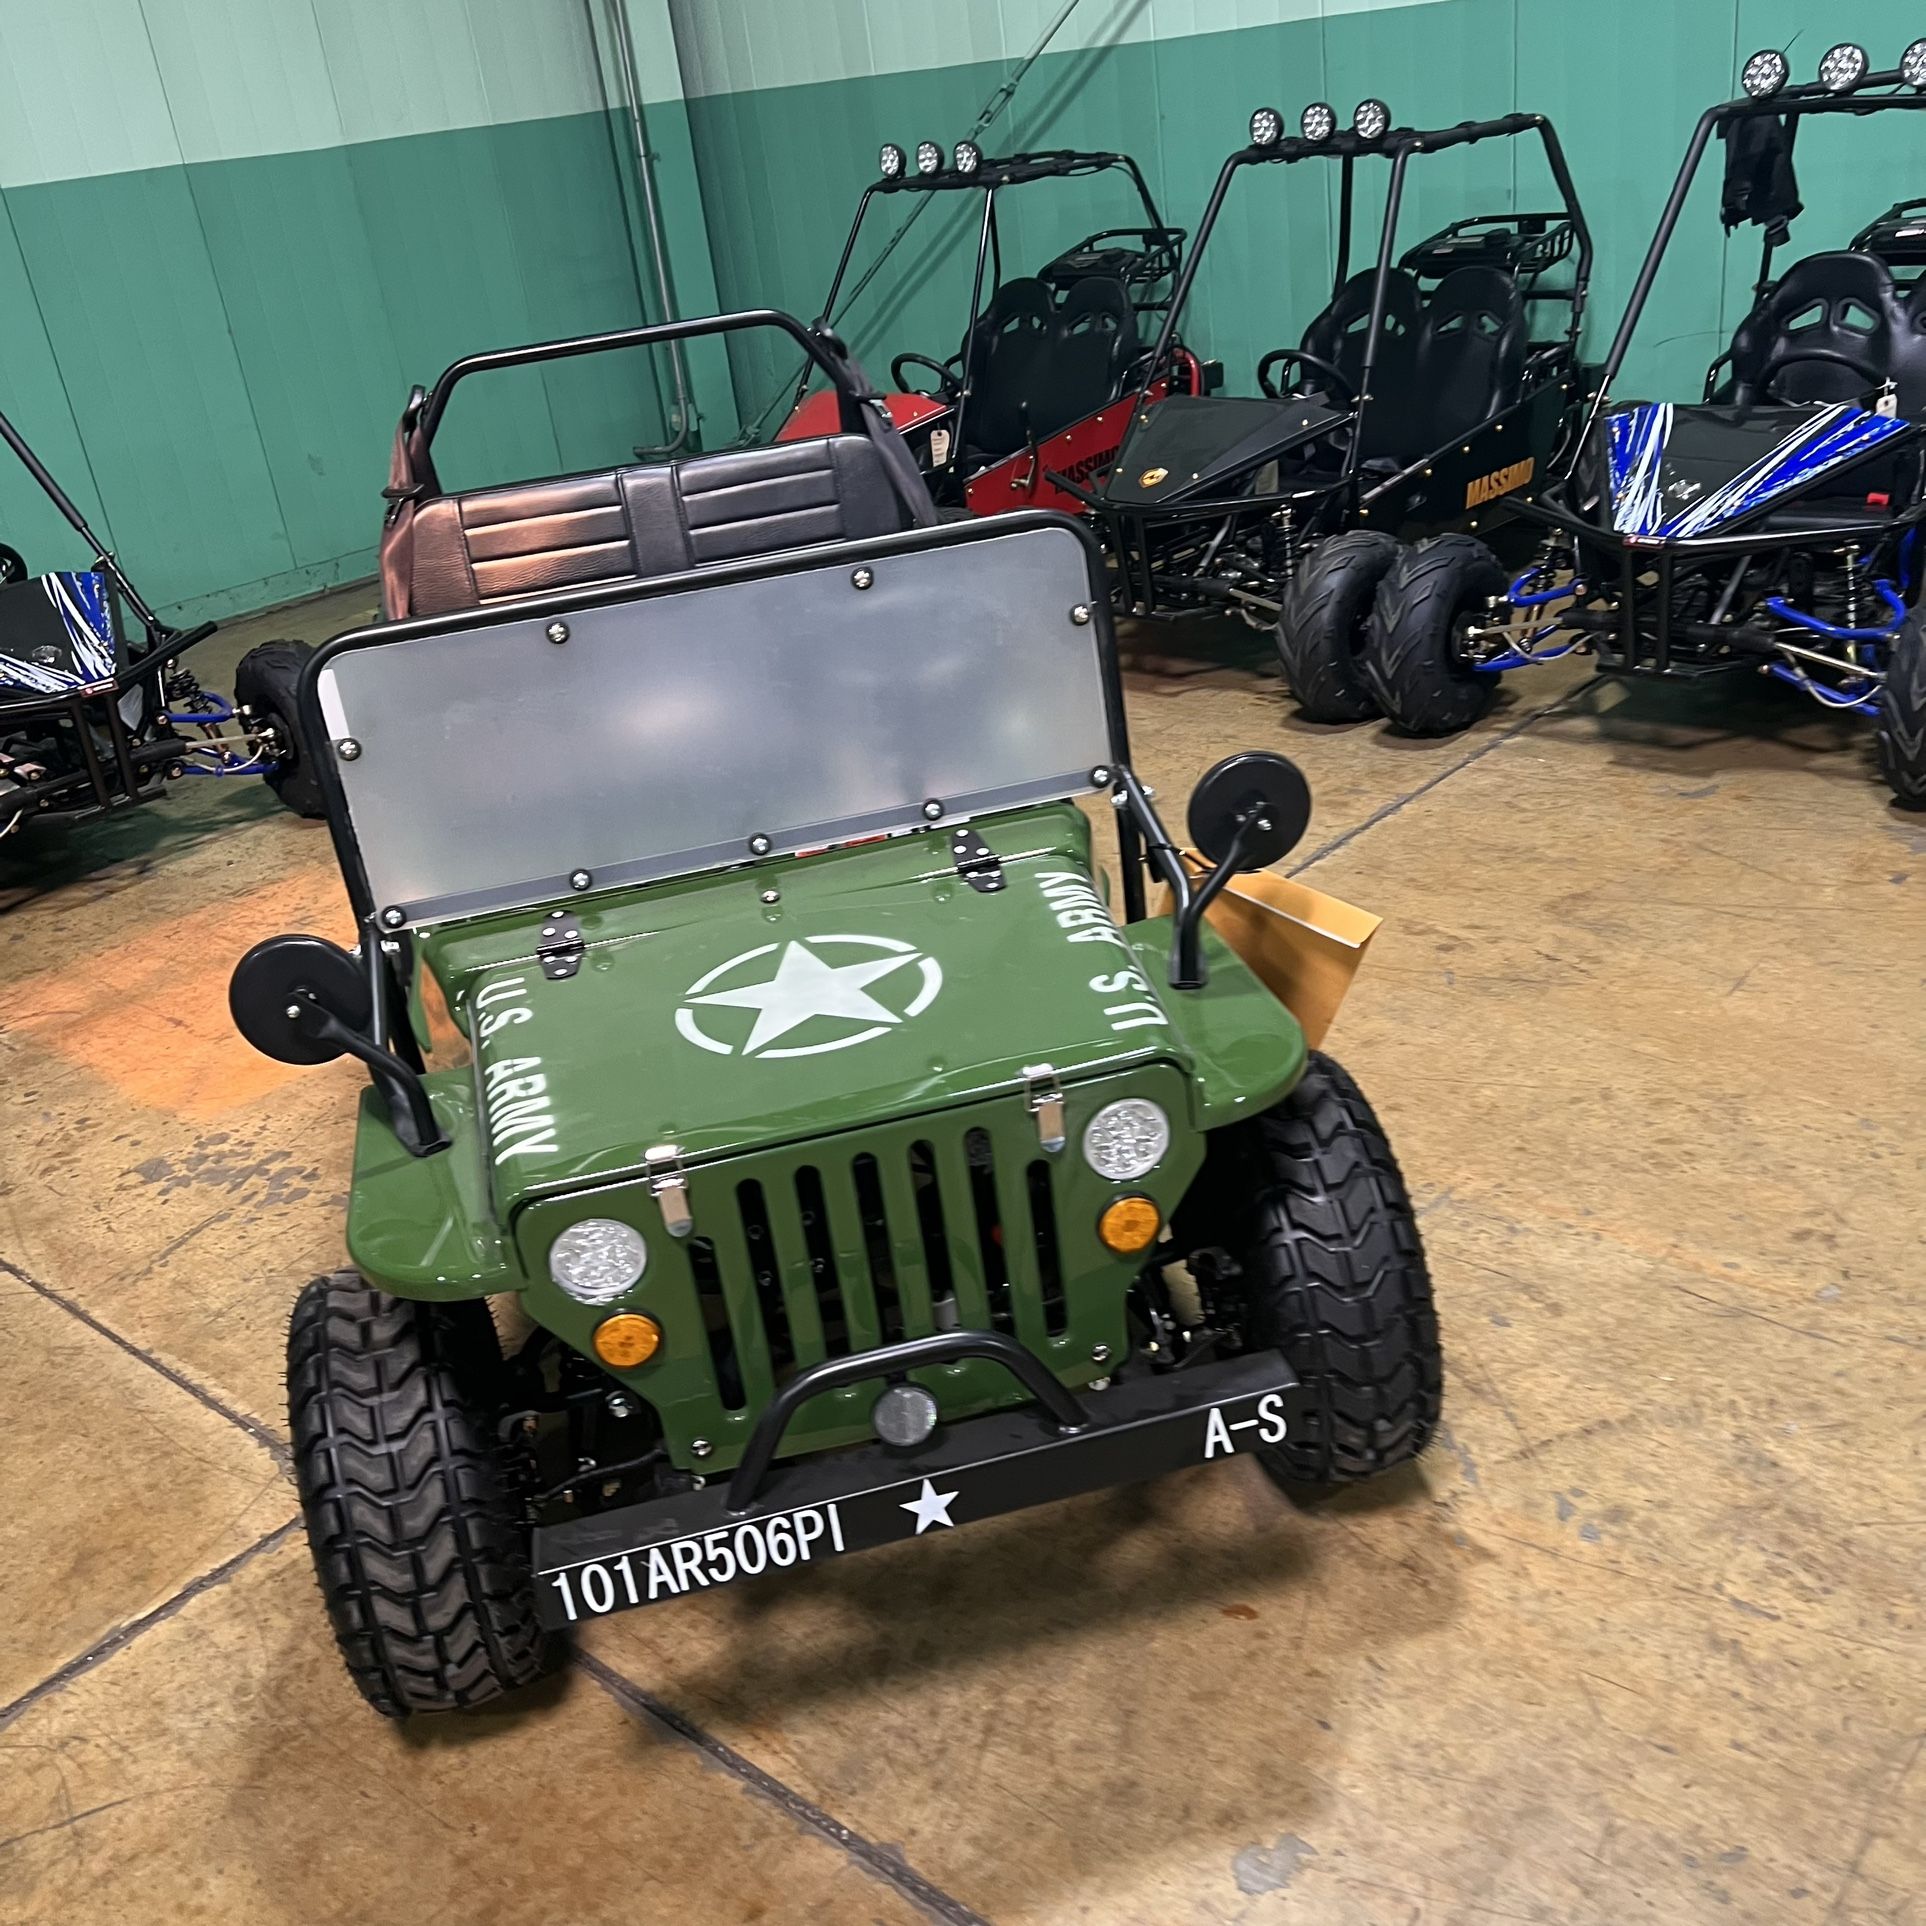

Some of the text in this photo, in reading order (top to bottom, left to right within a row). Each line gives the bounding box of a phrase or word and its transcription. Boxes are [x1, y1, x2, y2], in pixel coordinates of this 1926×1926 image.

[1465, 457, 1535, 509] MASSIMO
[1034, 872, 1169, 1031] U.S. ARMY
[476, 976, 559, 1166] U.S. ARMY
[1204, 1393, 1288, 1459] A-S
[551, 1503, 845, 1621] 101AR506PI
